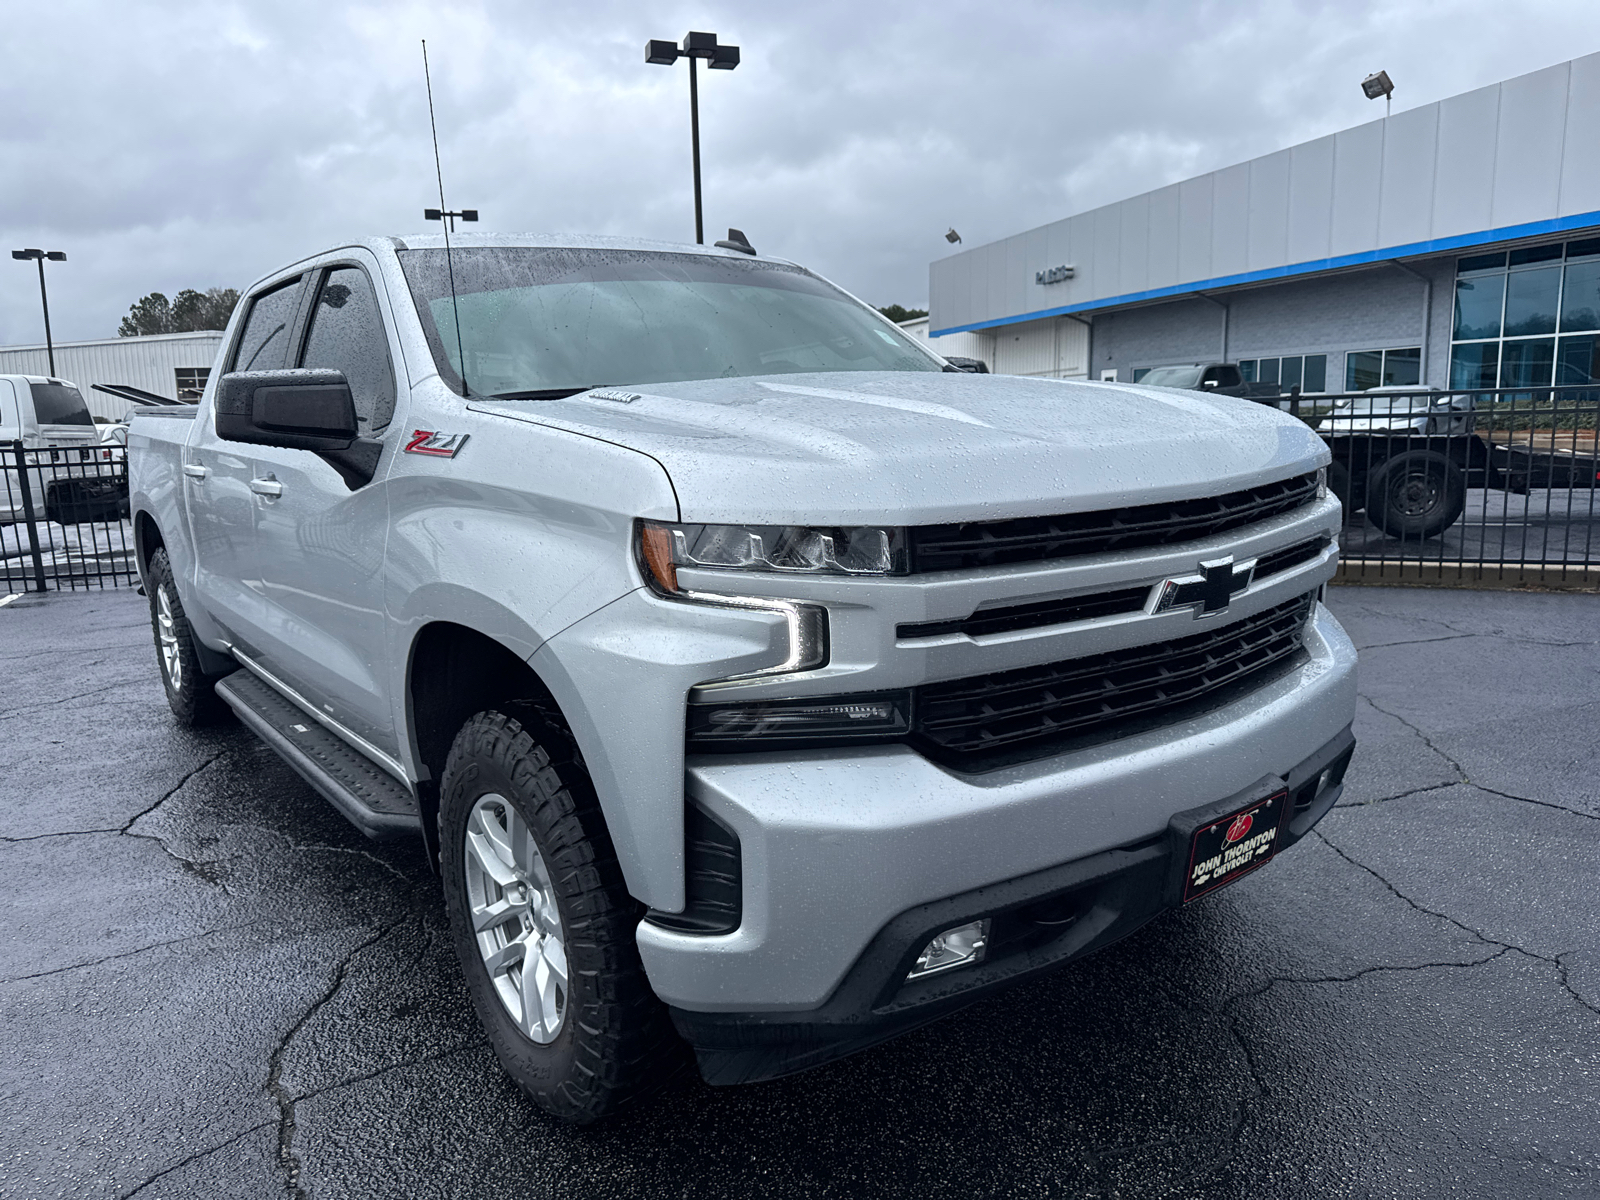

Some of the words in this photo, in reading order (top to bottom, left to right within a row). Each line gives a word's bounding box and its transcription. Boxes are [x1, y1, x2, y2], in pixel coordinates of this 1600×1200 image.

[404, 429, 470, 459] Z71
[1191, 854, 1222, 879] JOHN
[1224, 827, 1277, 862] THORNTON
[1213, 850, 1253, 879] CHEVROLET
